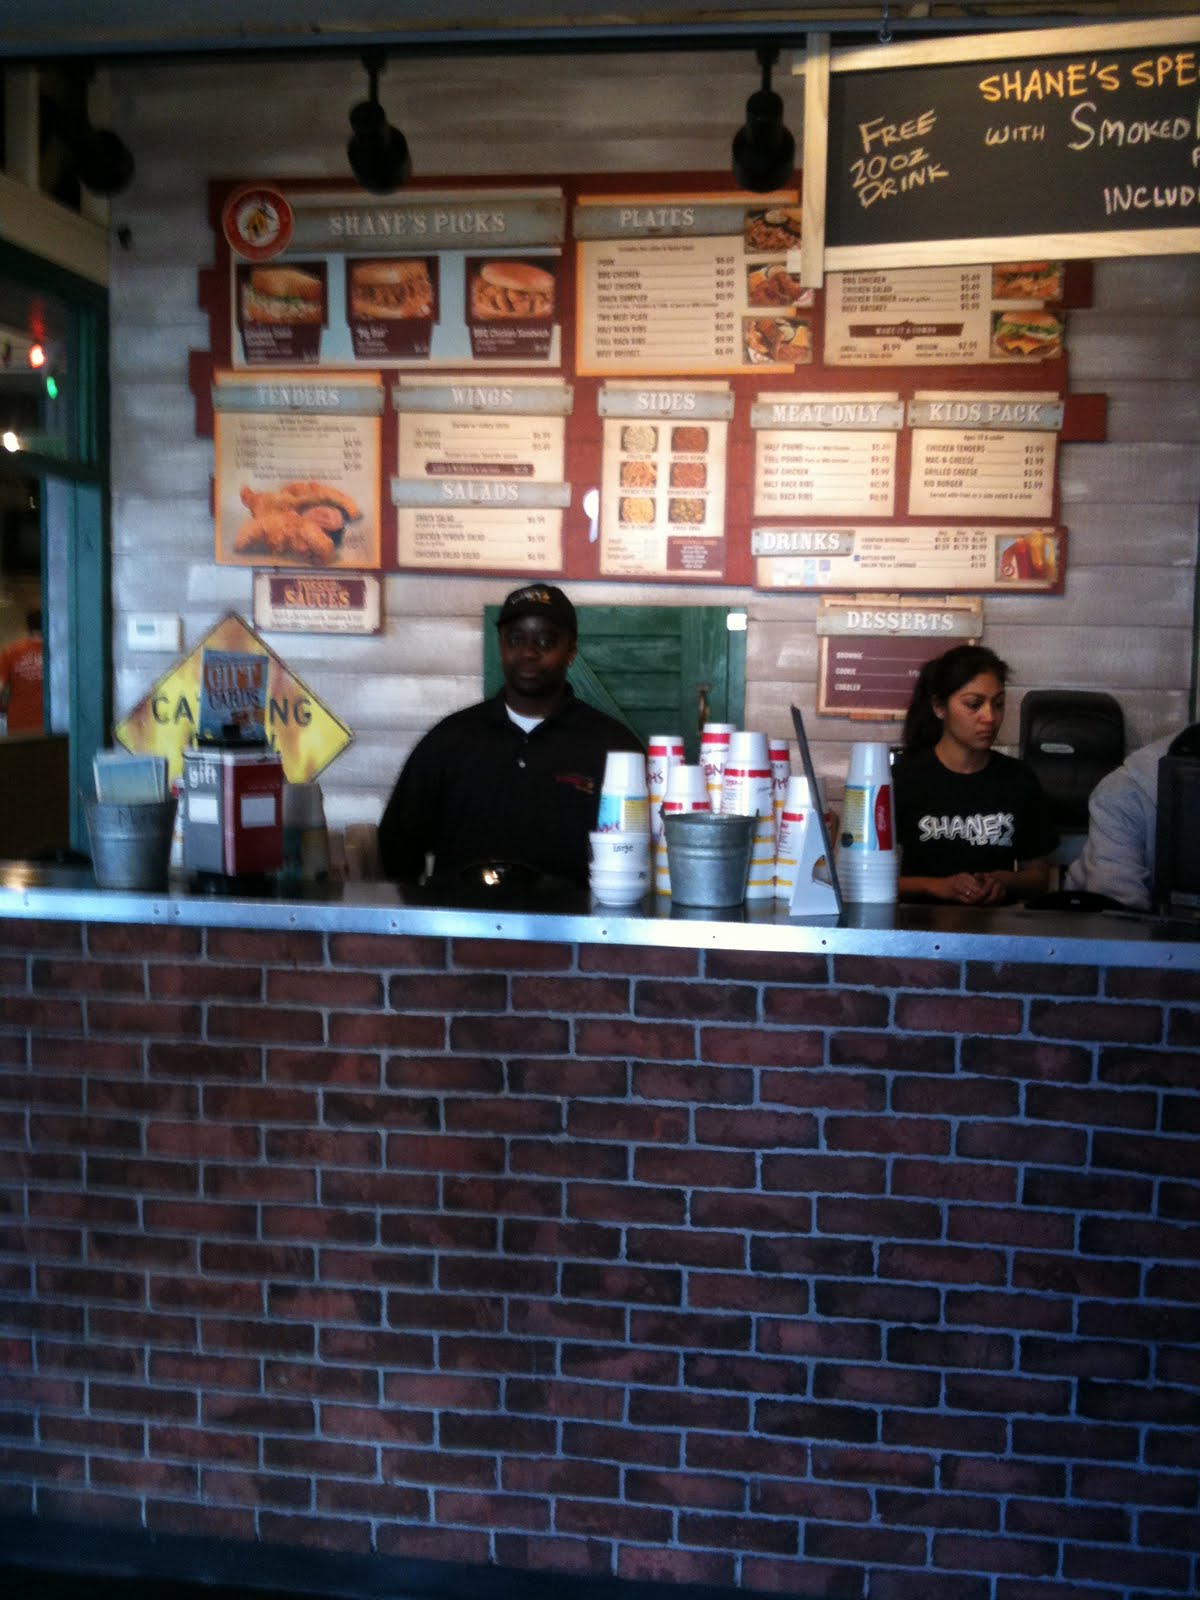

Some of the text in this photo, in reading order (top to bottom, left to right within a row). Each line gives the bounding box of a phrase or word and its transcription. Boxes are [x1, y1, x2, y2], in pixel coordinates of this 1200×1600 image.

[979, 53, 1200, 102] SHANE'S SPE
[858, 109, 937, 153] FREE
[984, 126, 1045, 146] WITH
[857, 162, 949, 208] DRINK
[1104, 184, 1200, 215] INCLUD
[329, 212, 506, 236] SHANE'S PICKS
[619, 208, 695, 228] PLATES
[255, 388, 340, 407] TENDERS
[451, 388, 513, 406] WINGS
[637, 391, 697, 411] SIDES
[772, 403, 883, 423] MEAT ONLY
[929, 403, 1041, 423] KIDS PACK
[442, 482, 519, 502] SALADS
[763, 532, 840, 551] DRINKS
[284, 589, 350, 609] SAUCES
[846, 611, 955, 631] DESSERTS
[918, 811, 1016, 842] SHANE'S
